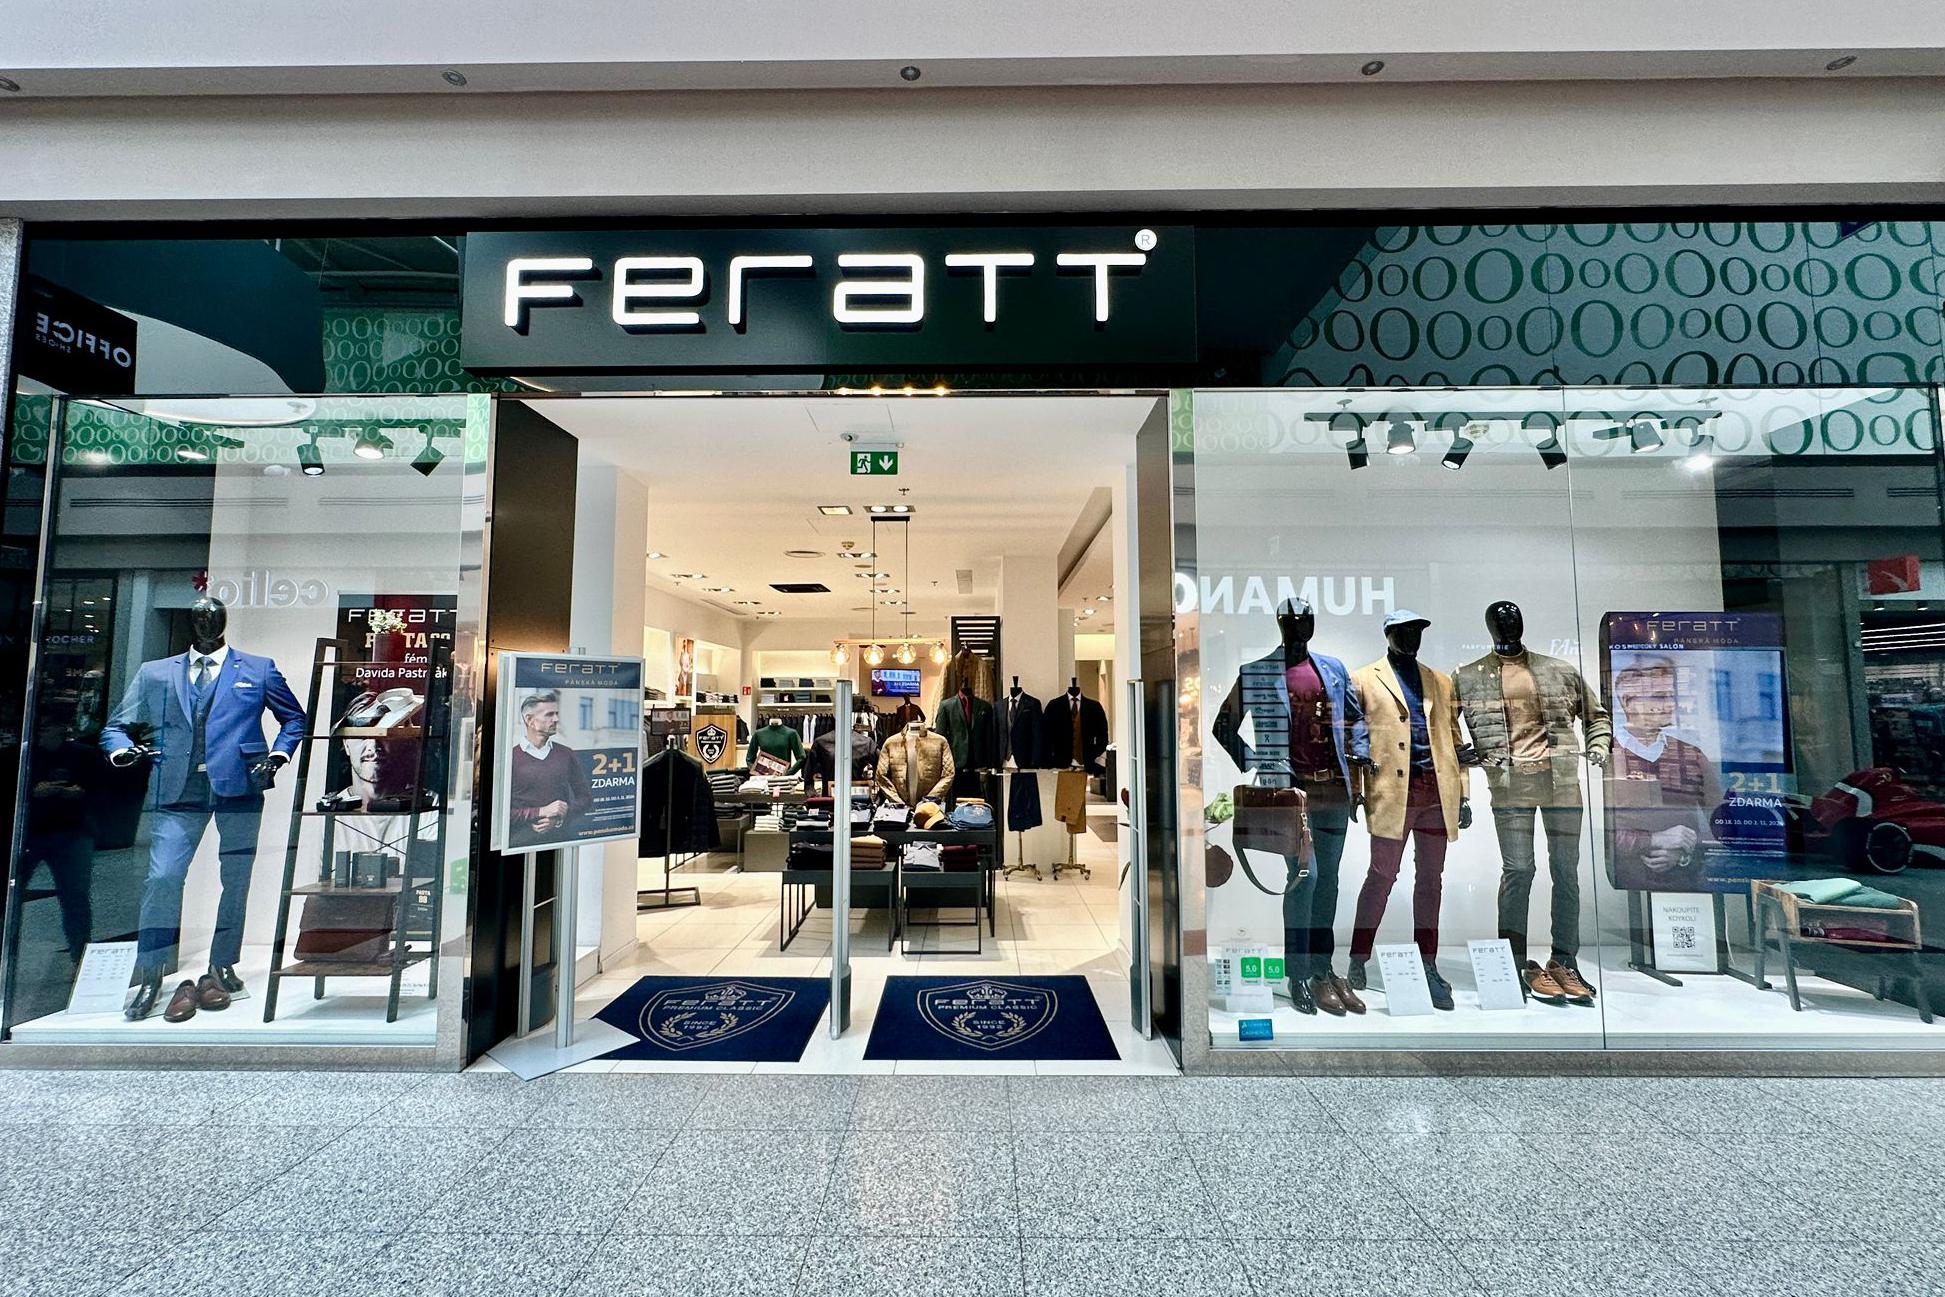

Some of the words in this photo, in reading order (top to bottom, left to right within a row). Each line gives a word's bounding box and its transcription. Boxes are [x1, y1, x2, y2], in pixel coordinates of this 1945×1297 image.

[356, 667, 395, 678] Davida
[592, 752, 636, 775] 2+1
[591, 776, 635, 789] ZDARMA
[1729, 772, 1781, 793] 2+1
[1729, 797, 1782, 807] ZDARMA
